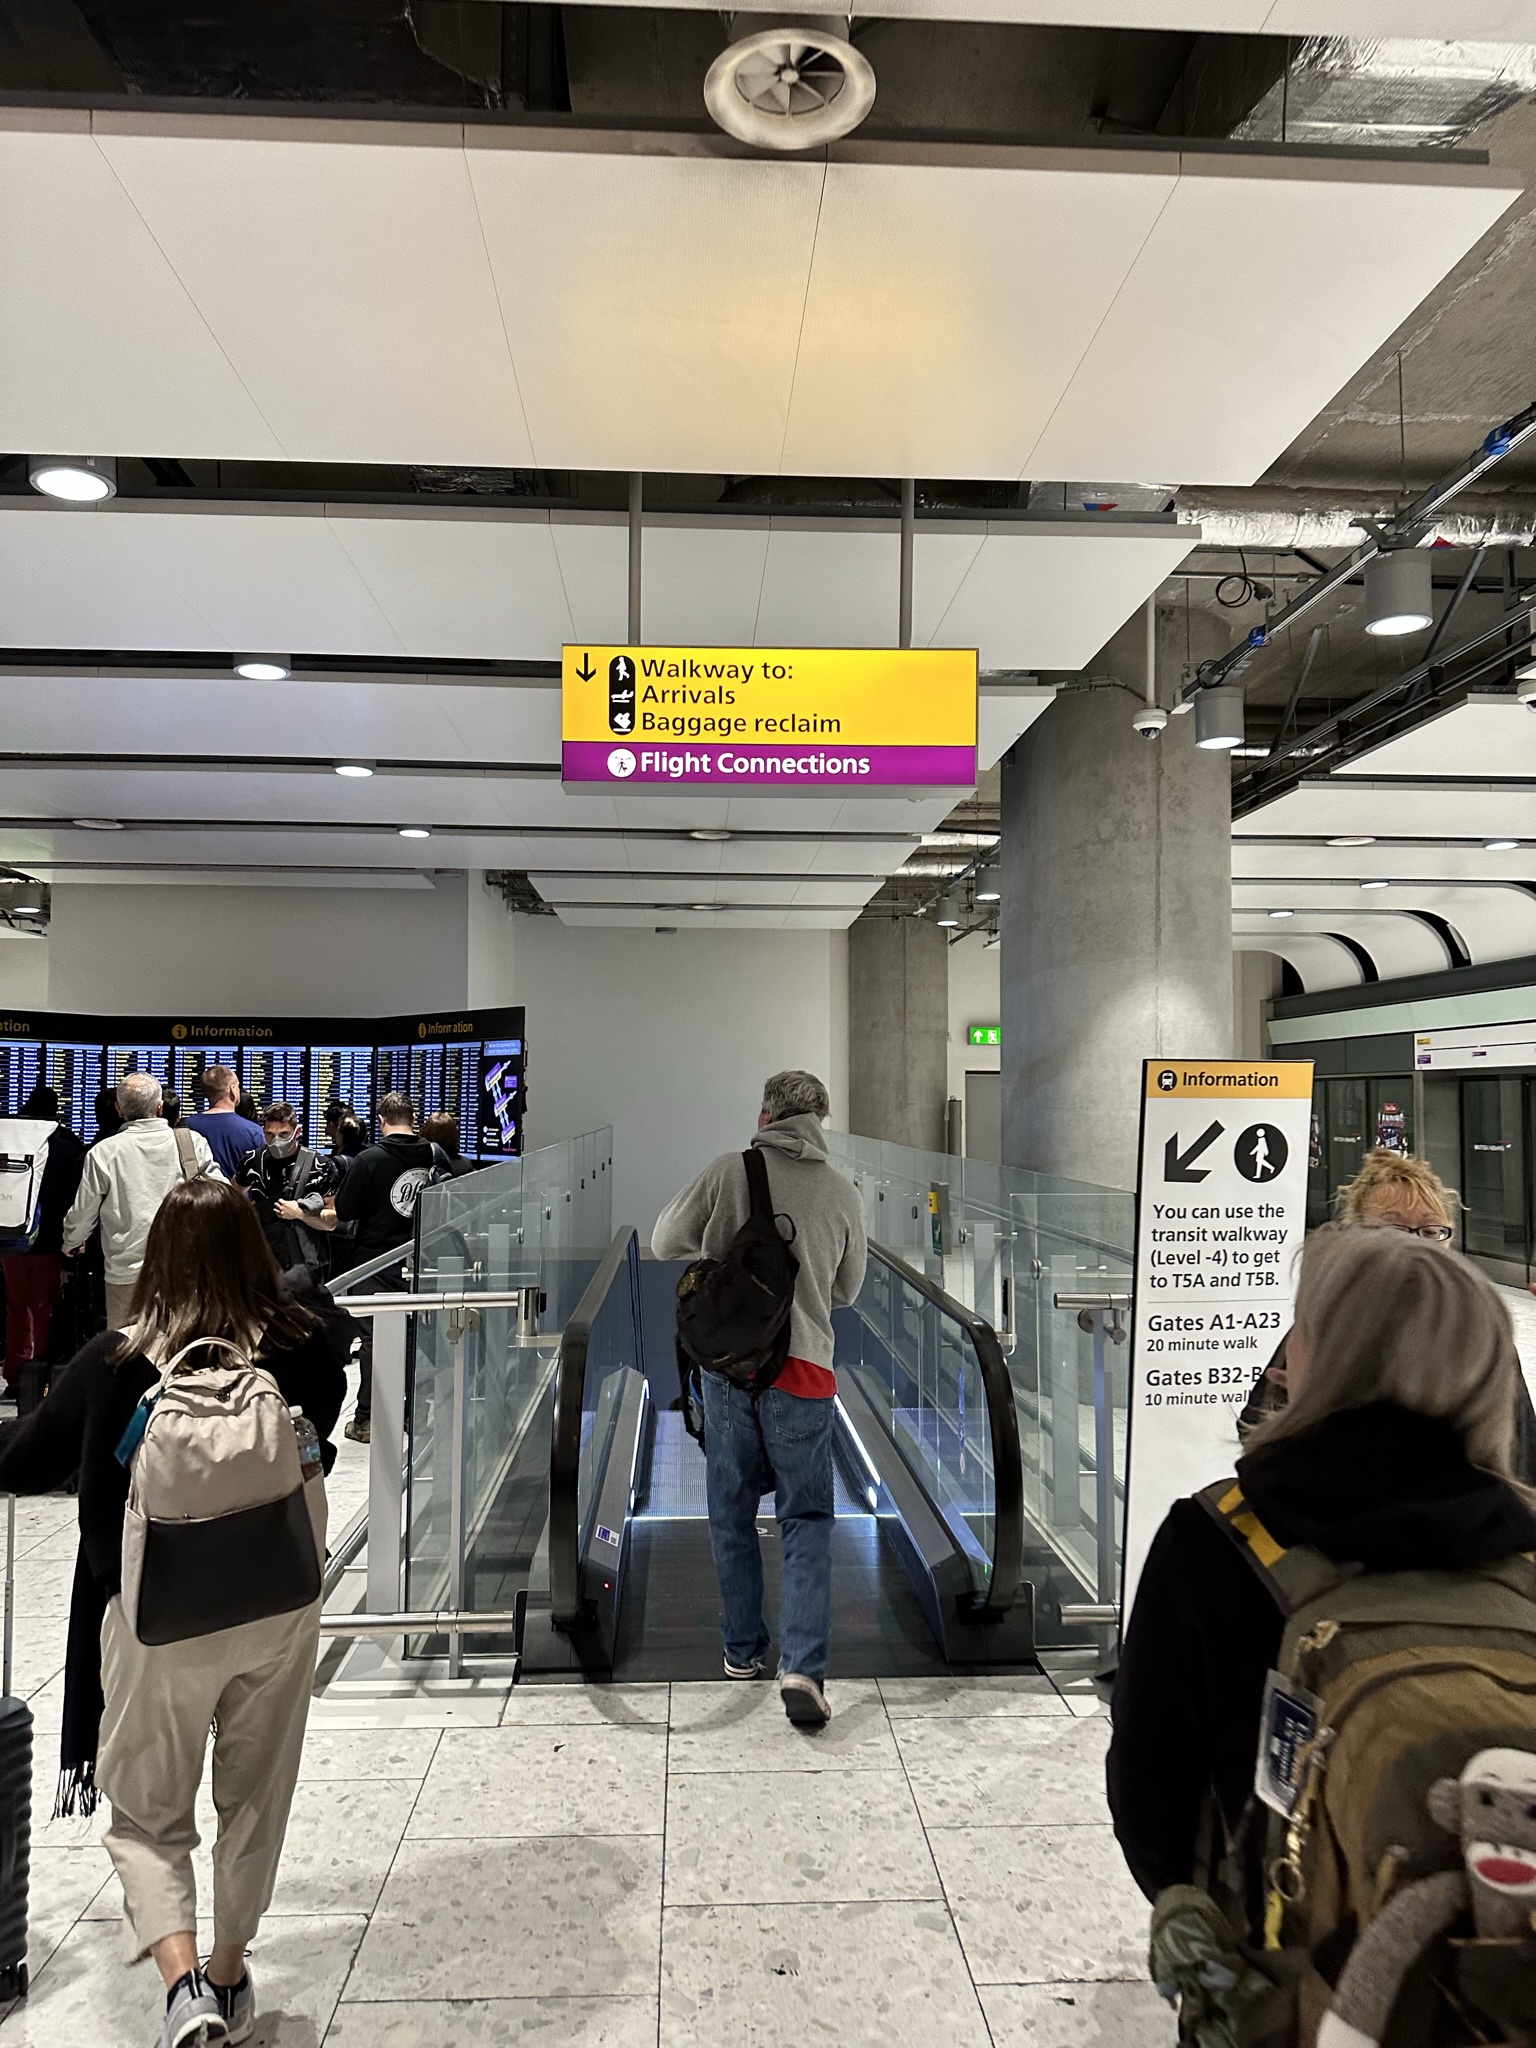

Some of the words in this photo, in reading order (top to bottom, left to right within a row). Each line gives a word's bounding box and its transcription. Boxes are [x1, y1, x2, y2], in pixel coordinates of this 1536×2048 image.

[641, 659, 754, 684] Walkway
[762, 662, 793, 679] to:
[641, 684, 736, 705] Arrivals
[642, 712, 747, 737] Baggage
[755, 713, 841, 733] reclaim
[641, 751, 711, 778] Flight
[717, 752, 870, 775] Connections
[191, 1025, 273, 1037] Information
[428, 1021, 473, 1034] Information
[1183, 1071, 1279, 1087] Information
[1153, 1204, 1187, 1219] You
[1192, 1207, 1220, 1219] can
[1225, 1206, 1254, 1218] use
[1258, 1203, 1285, 1218] the
[1151, 1227, 1208, 1242] transit
[1212, 1226, 1289, 1245] walkway
[1150, 1249, 1201, 1268] (Level
[1206, 1248, 1228, 1267] -4)
[1232, 1251, 1250, 1264] to
[1253, 1250, 1281, 1268] get
[1150, 1275, 1168, 1288] to
[1172, 1273, 1206, 1288] T5A
[1209, 1272, 1241, 1287] and
[1245, 1271, 1279, 1287] T5B.
[1148, 1315, 1204, 1332] Gates
[1209, 1312, 1281, 1331] A1-A23
[1147, 1339, 1164, 1352] 20
[1168, 1338, 1220, 1351] minute
[1223, 1336, 1258, 1349] walk
[1146, 1369, 1203, 1386] Gates
[1145, 1393, 1163, 1406] 10
[1166, 1392, 1218, 1405] minute
[1221, 1389, 1251, 1403] wal
